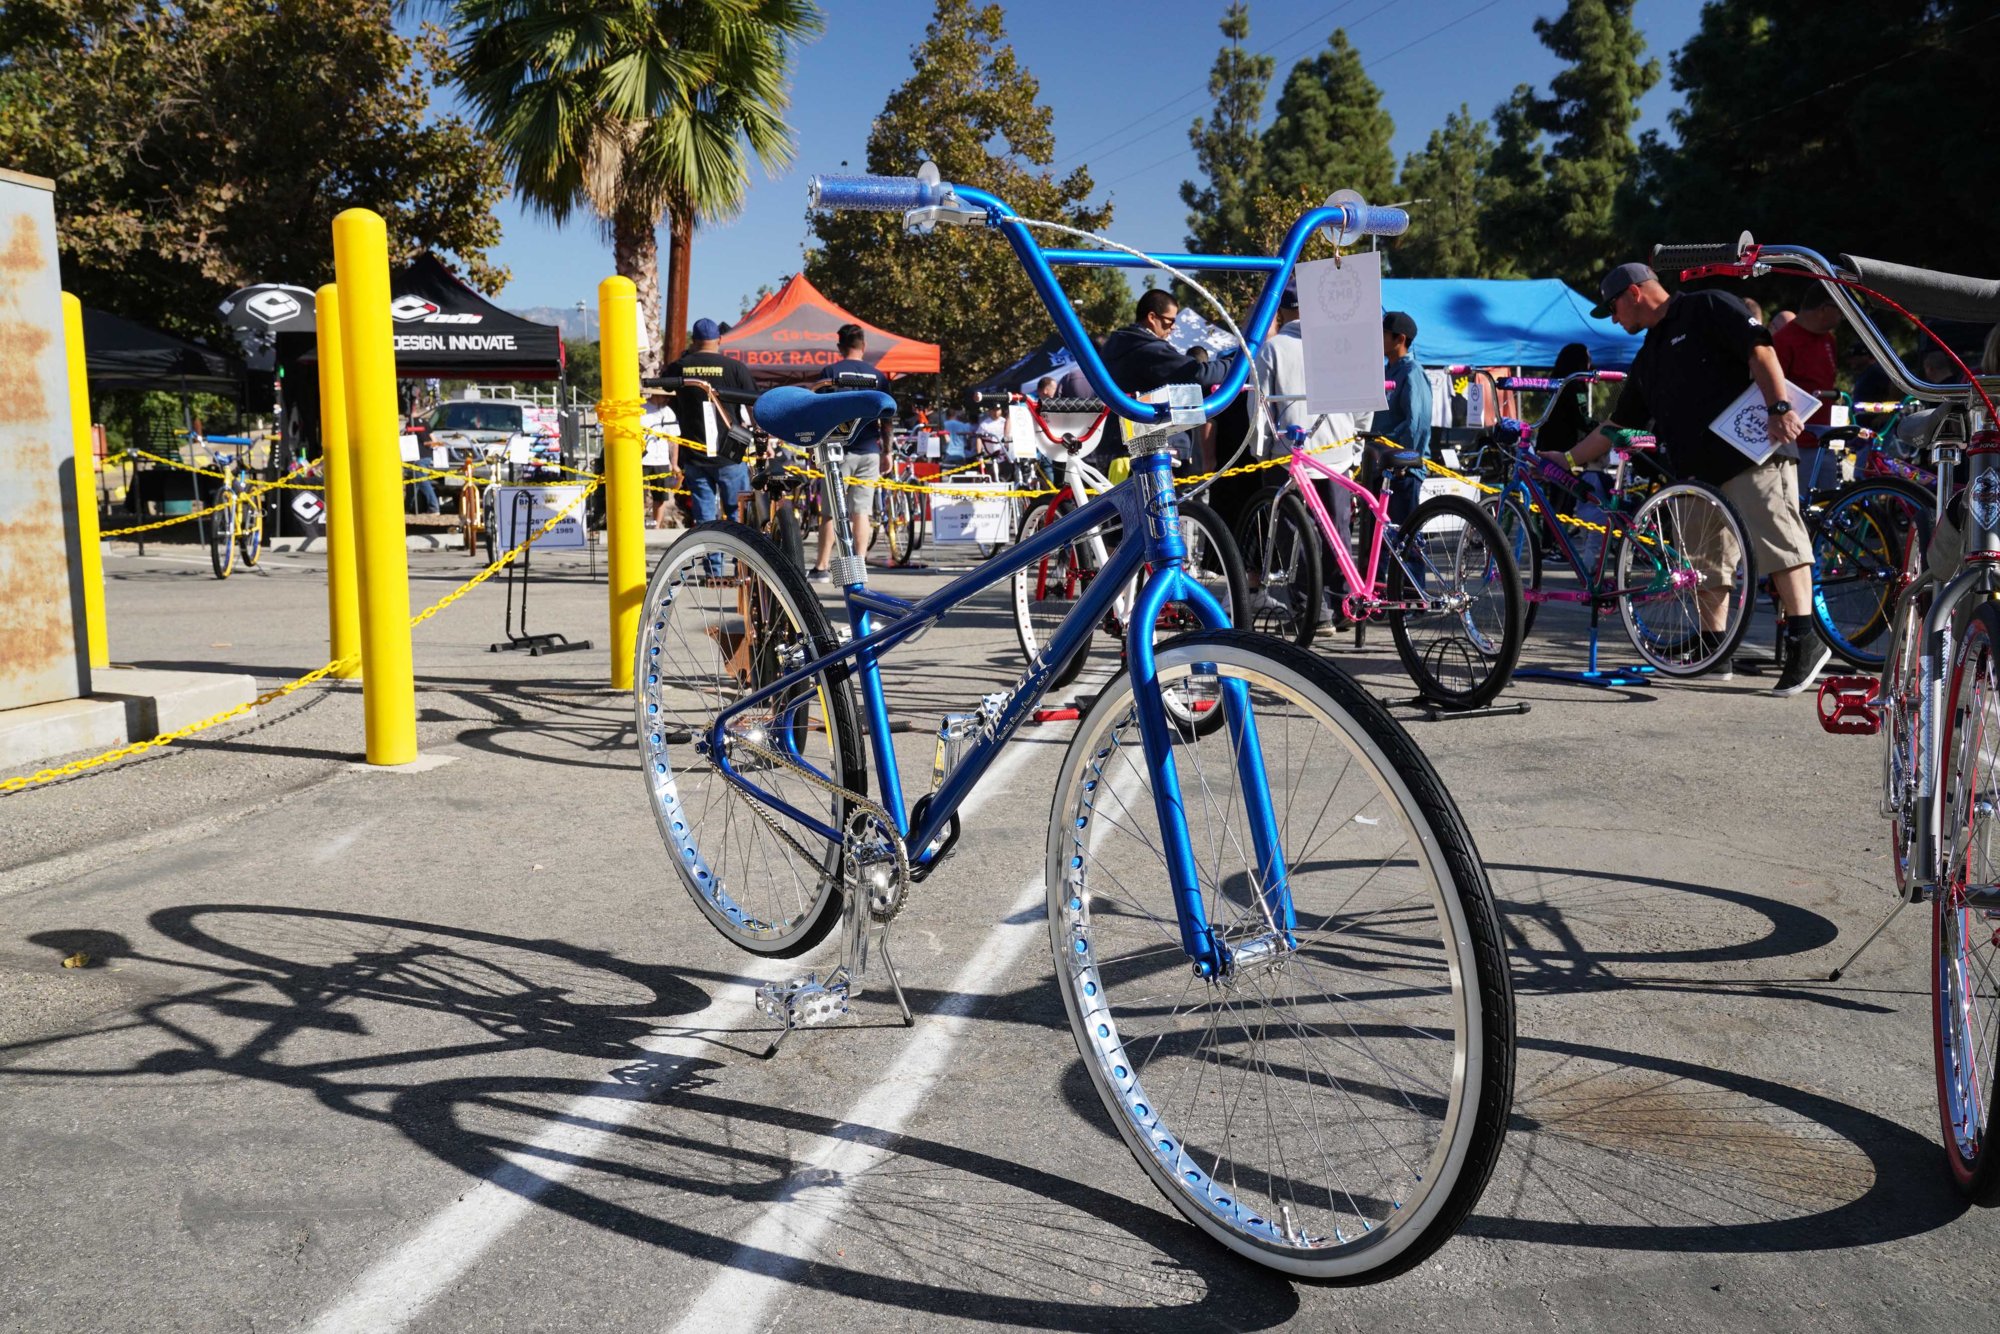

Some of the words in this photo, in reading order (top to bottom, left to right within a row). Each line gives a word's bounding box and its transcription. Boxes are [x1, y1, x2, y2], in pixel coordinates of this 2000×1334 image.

[449, 335, 518, 350] INNOVATE.
[747, 351, 785, 365] BOX
[789, 351, 845, 365] RACIN
